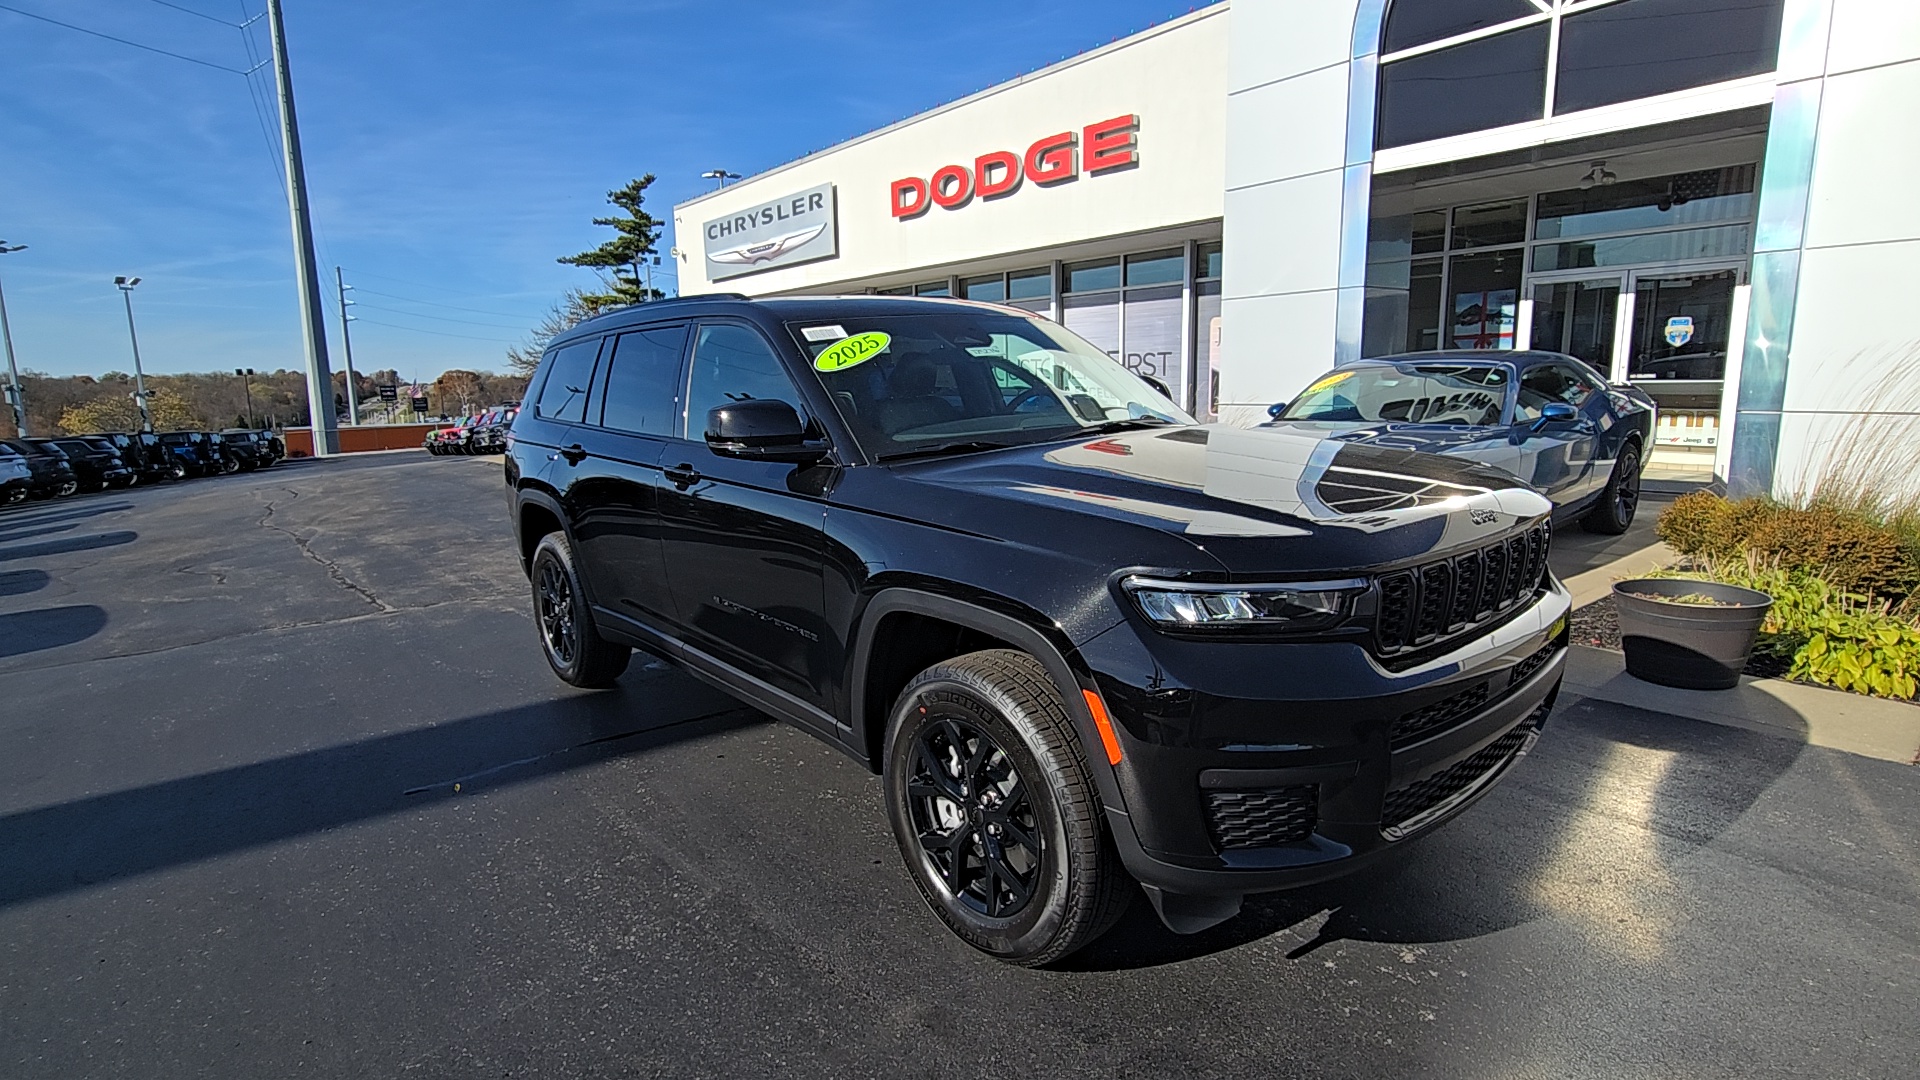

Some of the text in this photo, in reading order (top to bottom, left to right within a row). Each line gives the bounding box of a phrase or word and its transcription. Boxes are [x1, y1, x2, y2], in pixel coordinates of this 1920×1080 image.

[891, 114, 1138, 219] DODGE
[707, 192, 824, 240] CHRYSLER
[828, 335, 880, 367] 2025
